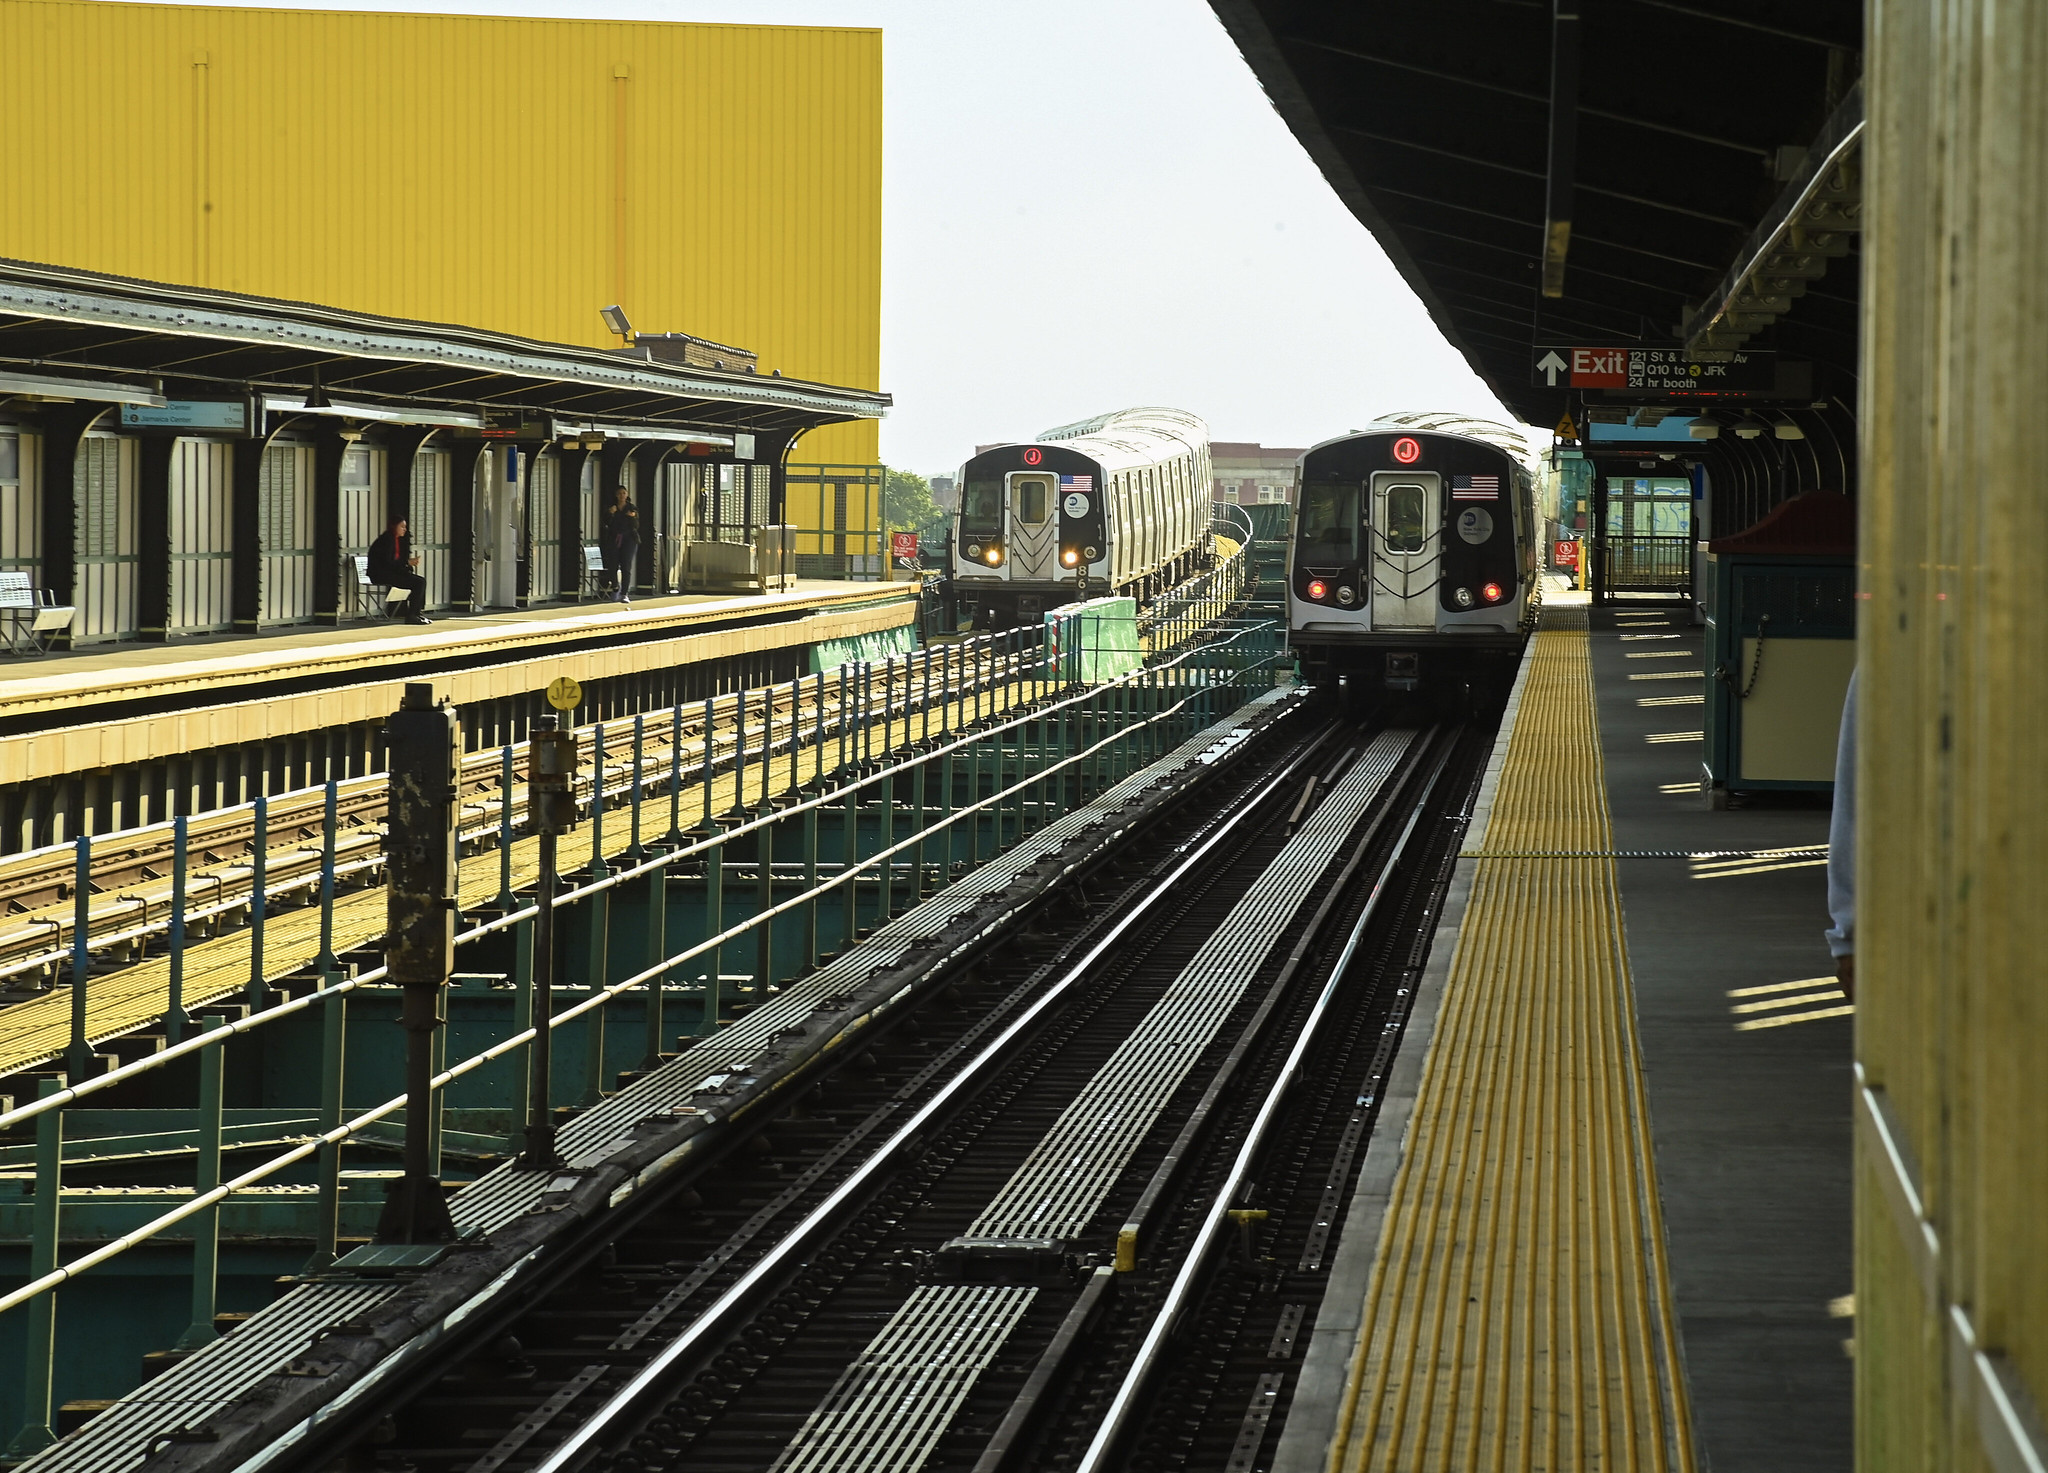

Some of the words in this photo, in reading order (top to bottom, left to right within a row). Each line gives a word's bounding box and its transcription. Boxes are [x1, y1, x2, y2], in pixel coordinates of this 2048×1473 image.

[1573, 350, 1624, 374] Exit
[1629, 351, 1647, 362] 121
[1650, 351, 1664, 362] St
[1667, 352, 1677, 363] &
[1733, 353, 1748, 364] Av
[1646, 364, 1670, 376] Q10
[1673, 365, 1686, 376] to
[1703, 365, 1727, 376] JFK
[1628, 377, 1644, 388] 24
[1647, 377, 1660, 388] hr
[1663, 378, 1697, 389] booth
[1560, 421, 1571, 434] Z
